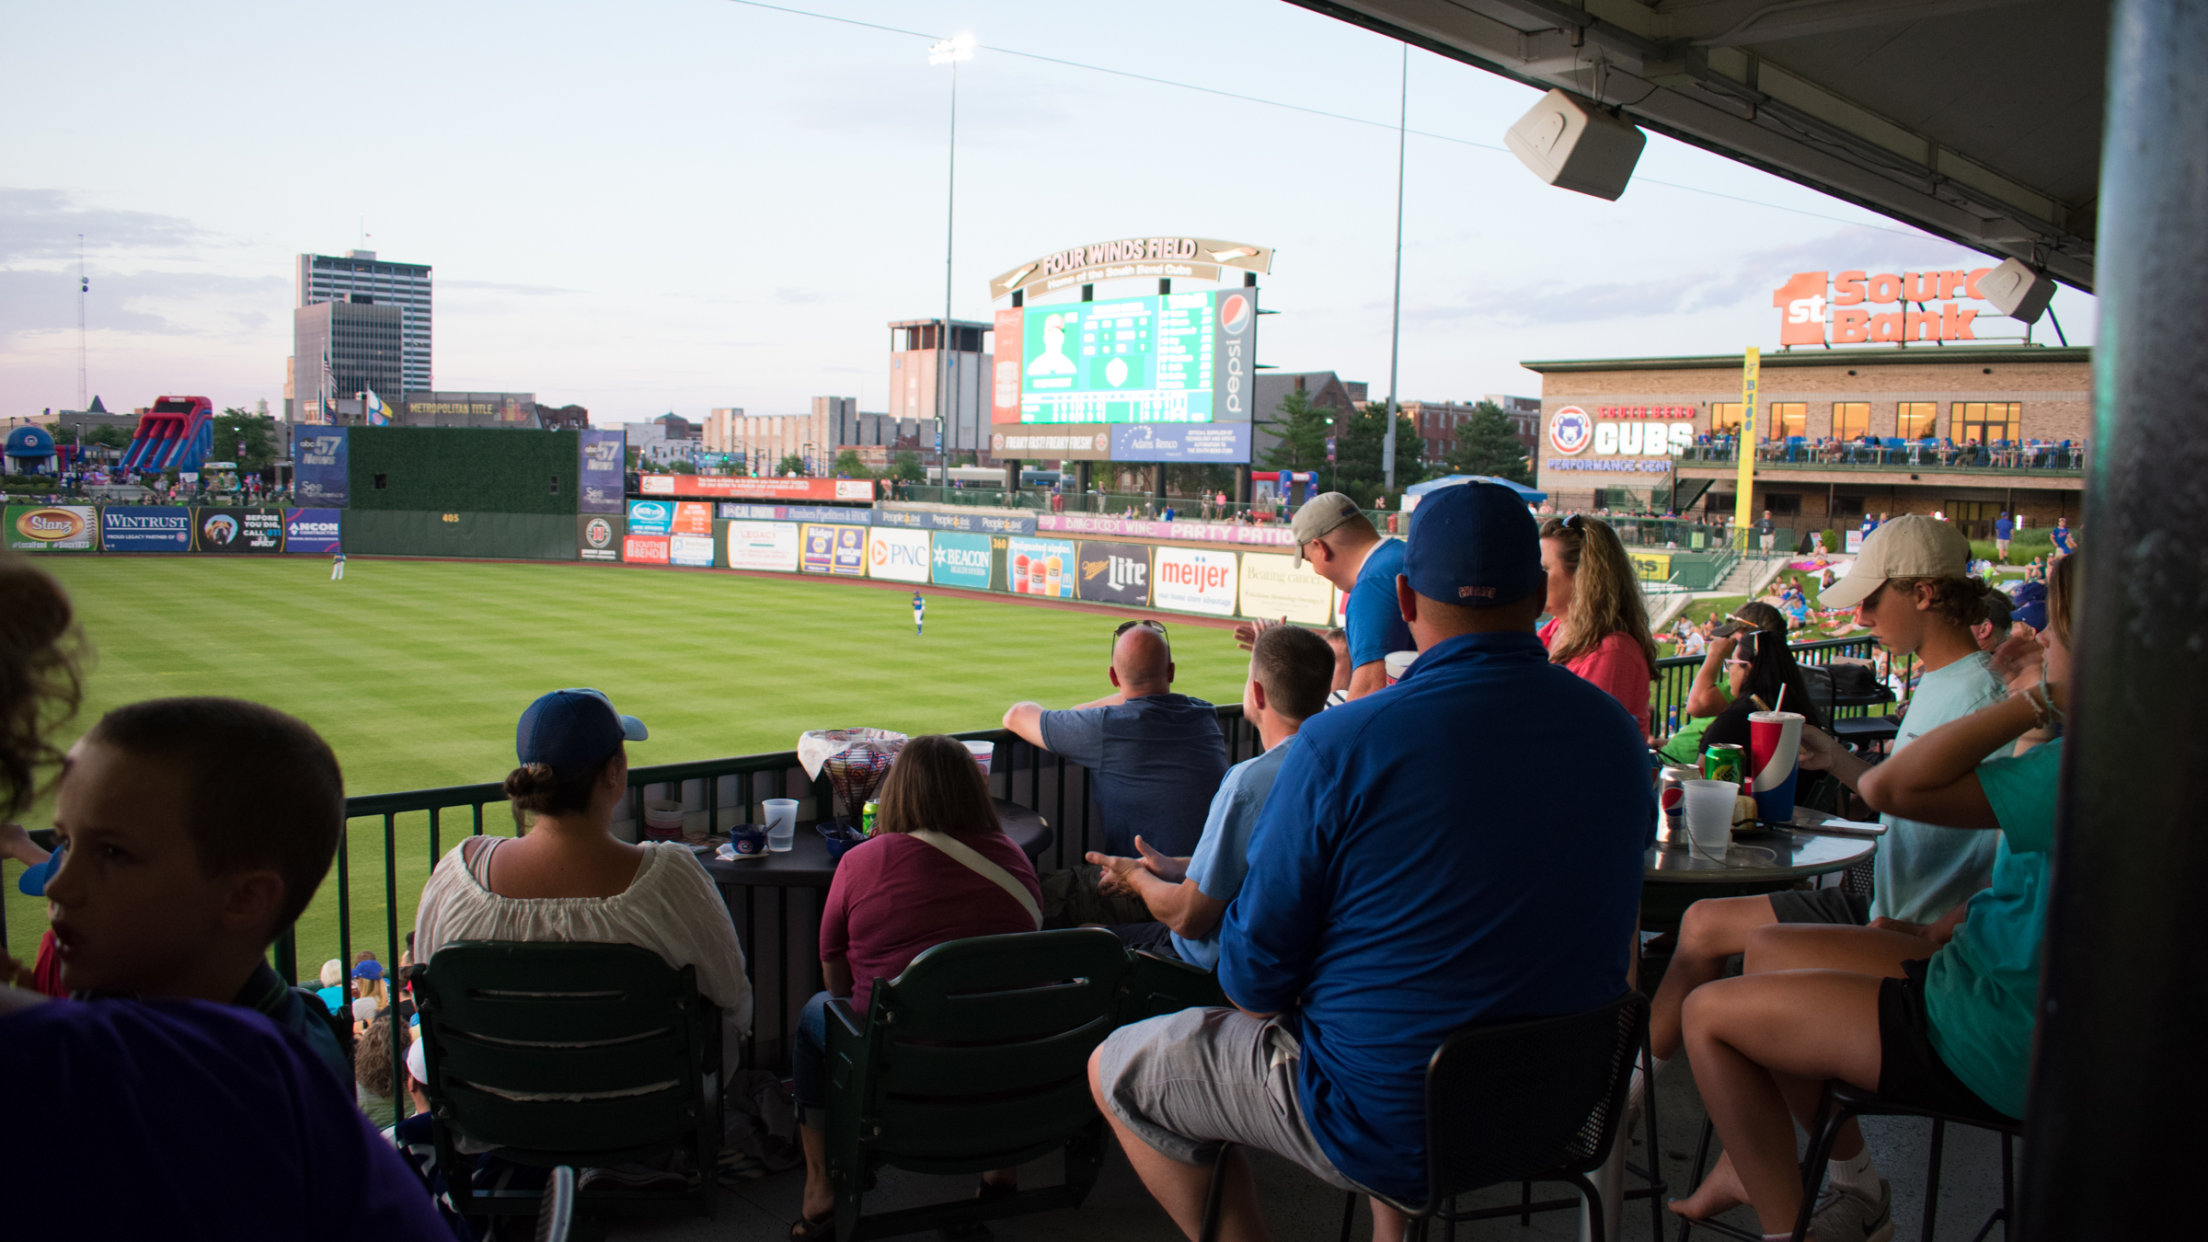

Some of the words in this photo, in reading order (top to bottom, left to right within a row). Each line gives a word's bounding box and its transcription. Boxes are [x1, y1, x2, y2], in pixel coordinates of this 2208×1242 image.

[1043, 248, 1087, 277] FOUR
[1089, 239, 1148, 265] WINDS
[1148, 238, 1198, 259] FIELD
[1047, 275, 1075, 290] Home
[1077, 271, 1088, 282] of
[1088, 268, 1105, 280] the
[1105, 265, 1135, 278] South
[1136, 264, 1164, 275] Bend
[1164, 264, 1192, 276] Cubs
[1834, 268, 1994, 306] Sourc
[1832, 303, 1979, 343] Bank
[1225, 337, 1243, 413] pepsi
[409, 402, 470, 414] METROPOLITAN
[471, 403, 494, 415] TITLE
[1597, 405, 1647, 418] SOUTH
[1651, 405, 1695, 419] BEND
[313, 436, 343, 456] 57
[1594, 422, 1694, 456] CUBS
[596, 441, 620, 461] 57
[1546, 459, 1636, 472] PERFORMANCE
[1639, 461, 1672, 473] CENT
[30, 515, 73, 535] Stanz
[106, 513, 188, 528] WINTRUST
[993, 538, 1007, 549] 360
[1170, 523, 1232, 541] PARTY
[1237, 526, 1294, 544] PATIO
[891, 544, 927, 567] PNC
[947, 549, 991, 568] BEACON
[1106, 555, 1147, 592] Lite
[1162, 556, 1229, 593] meijer
